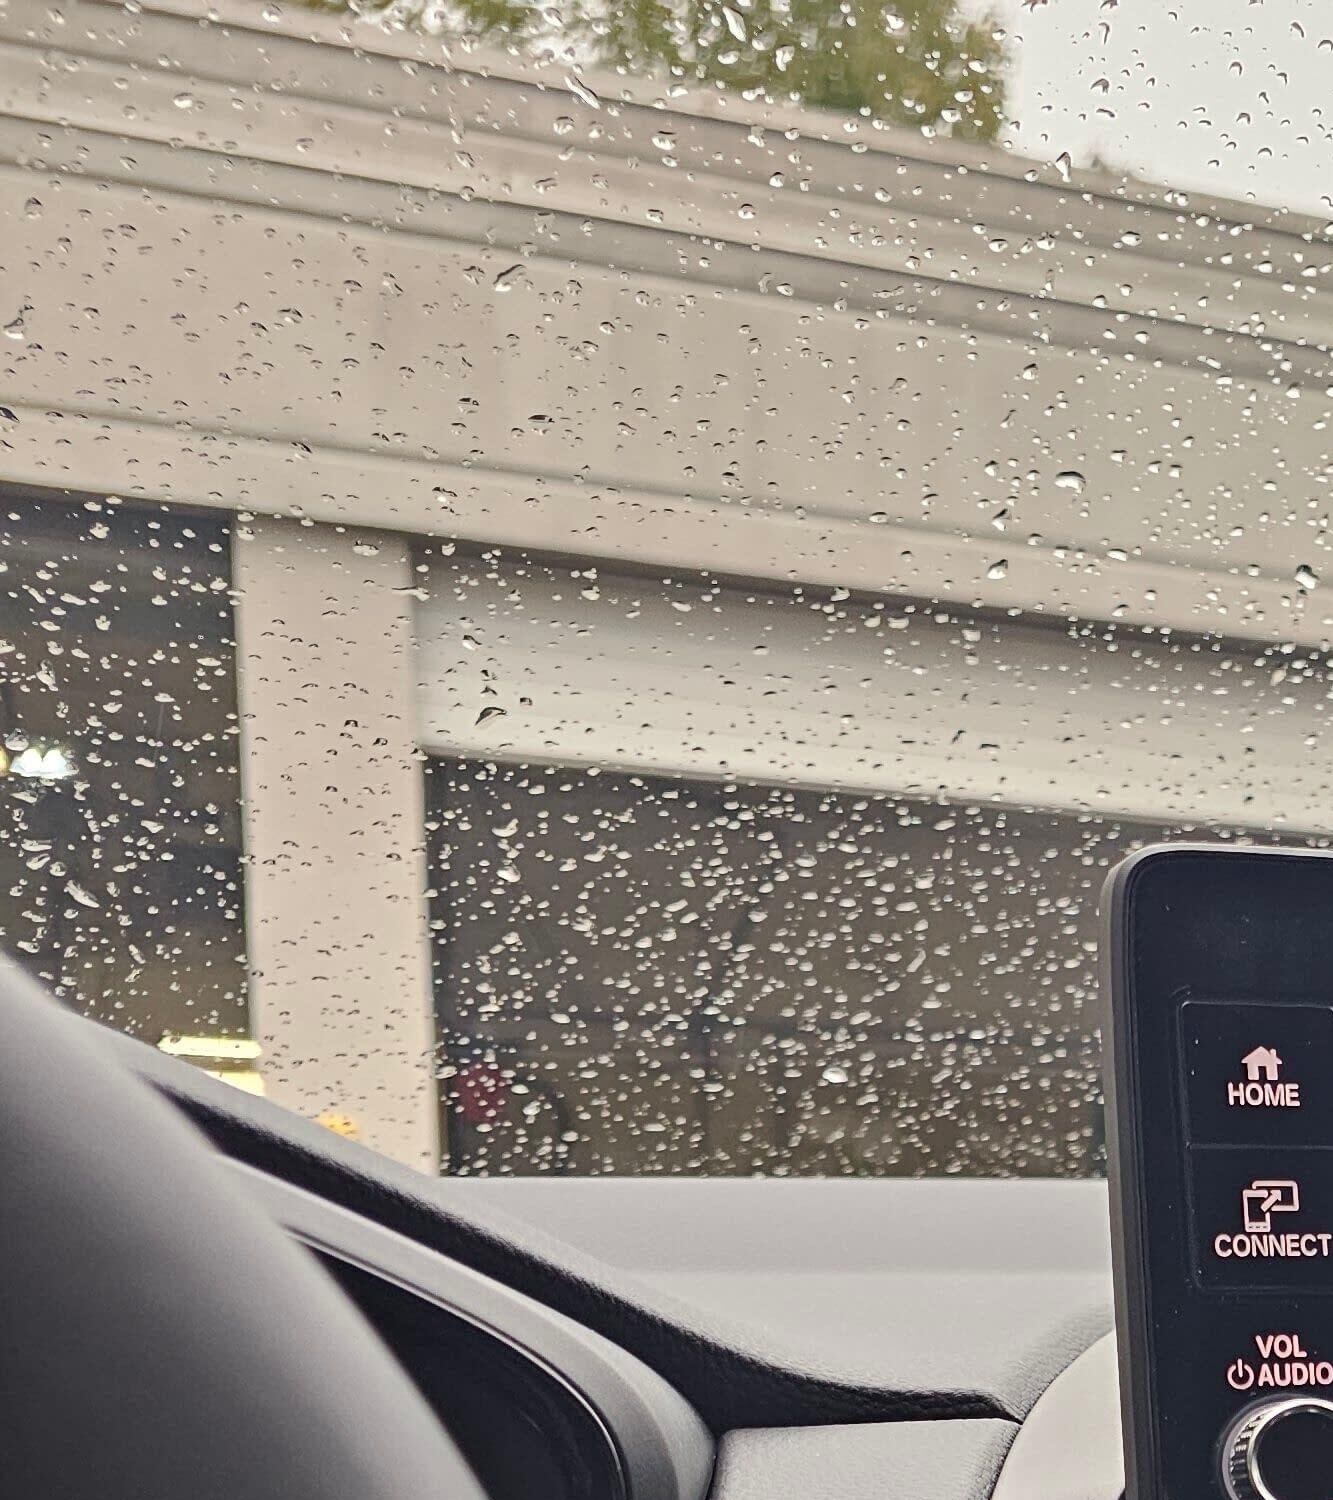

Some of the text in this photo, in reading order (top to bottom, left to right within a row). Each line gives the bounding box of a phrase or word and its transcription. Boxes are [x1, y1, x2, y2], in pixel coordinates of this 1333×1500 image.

[1228, 1082, 1300, 1108] HOME
[1214, 1233, 1332, 1259] CONNECT
[1256, 1334, 1307, 1358] VOL
